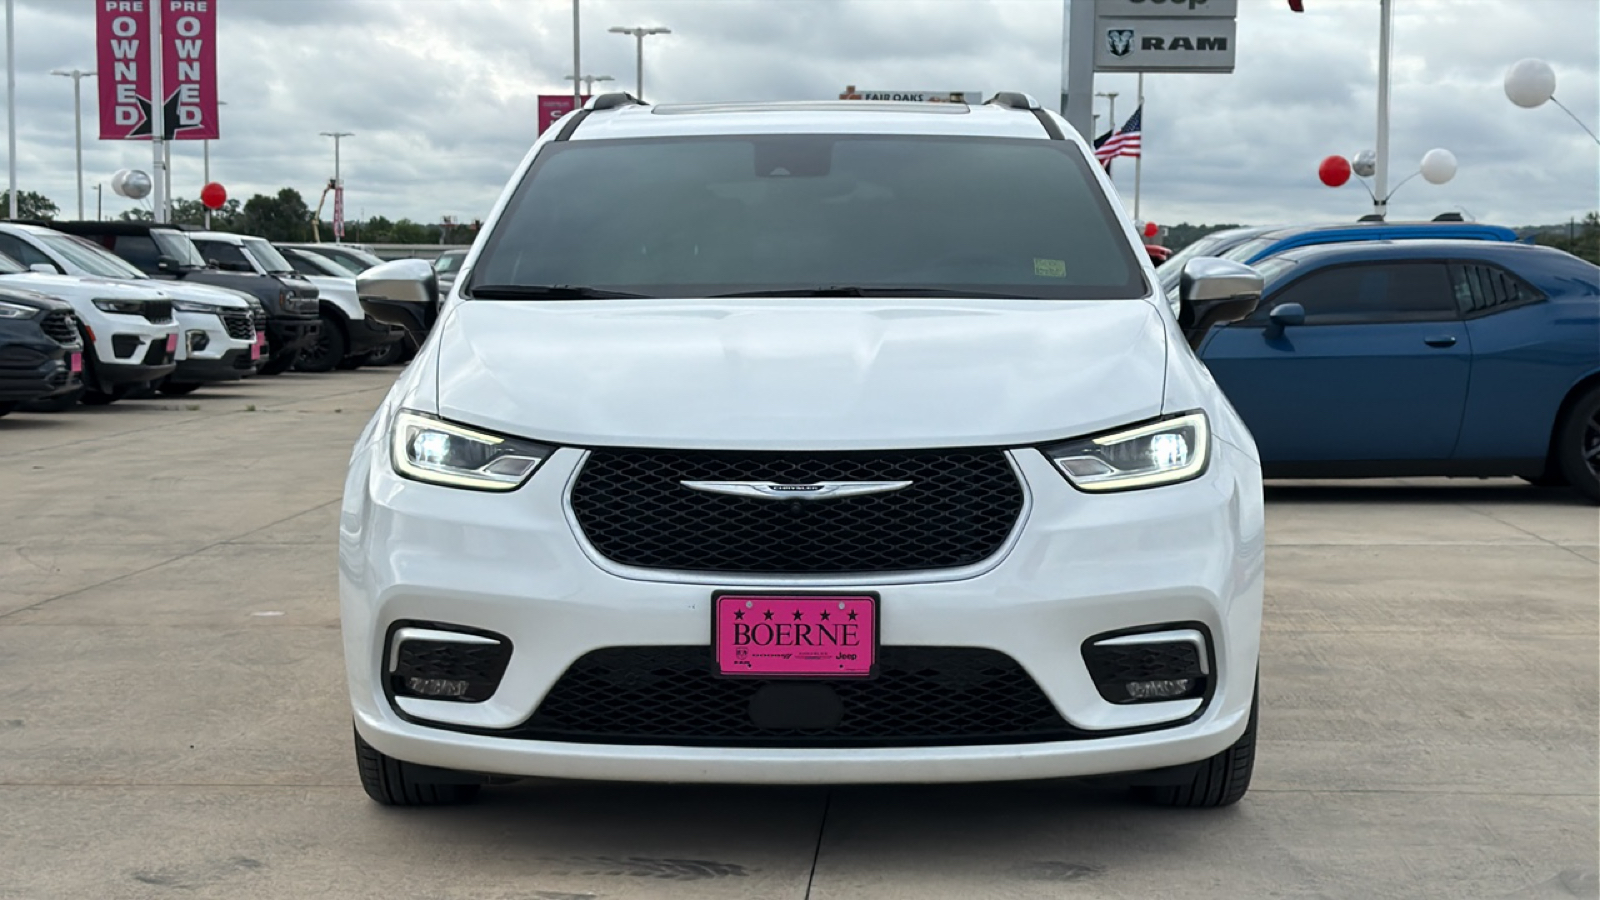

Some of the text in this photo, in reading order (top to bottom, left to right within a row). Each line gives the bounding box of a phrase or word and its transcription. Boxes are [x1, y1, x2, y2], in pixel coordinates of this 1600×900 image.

[106, 1, 143, 12] PRE
[171, 1, 207, 12] PRE
[1142, 37, 1227, 50] RAM
[110, 16, 139, 125] OWNED
[175, 16, 203, 125] OWNED
[865, 93, 924, 101] FAIR OAKS
[733, 623, 860, 646] BOERNE
